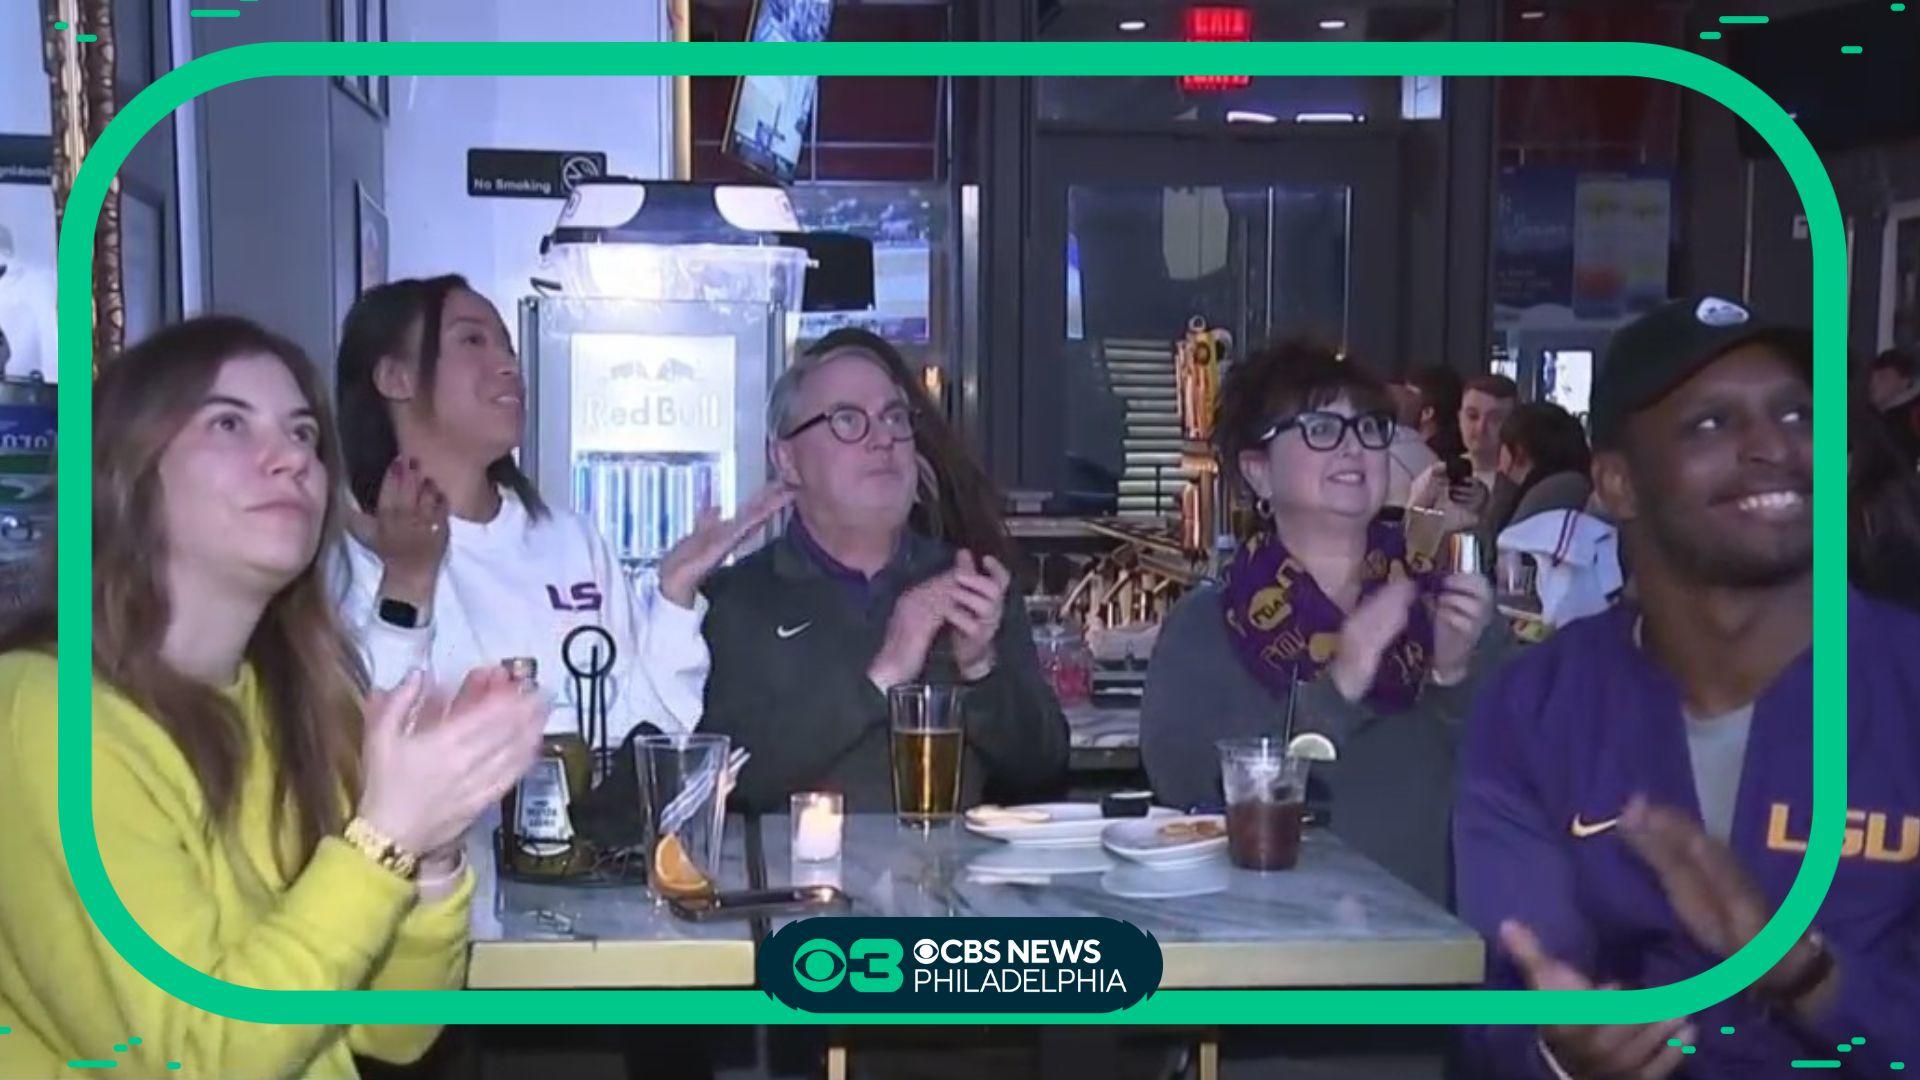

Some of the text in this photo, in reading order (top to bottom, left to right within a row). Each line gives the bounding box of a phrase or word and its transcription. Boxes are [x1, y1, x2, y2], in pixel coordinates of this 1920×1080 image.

[473, 178, 552, 195] No Smoking
[583, 395, 722, 429] Red Bull
[545, 582, 602, 611] LS
